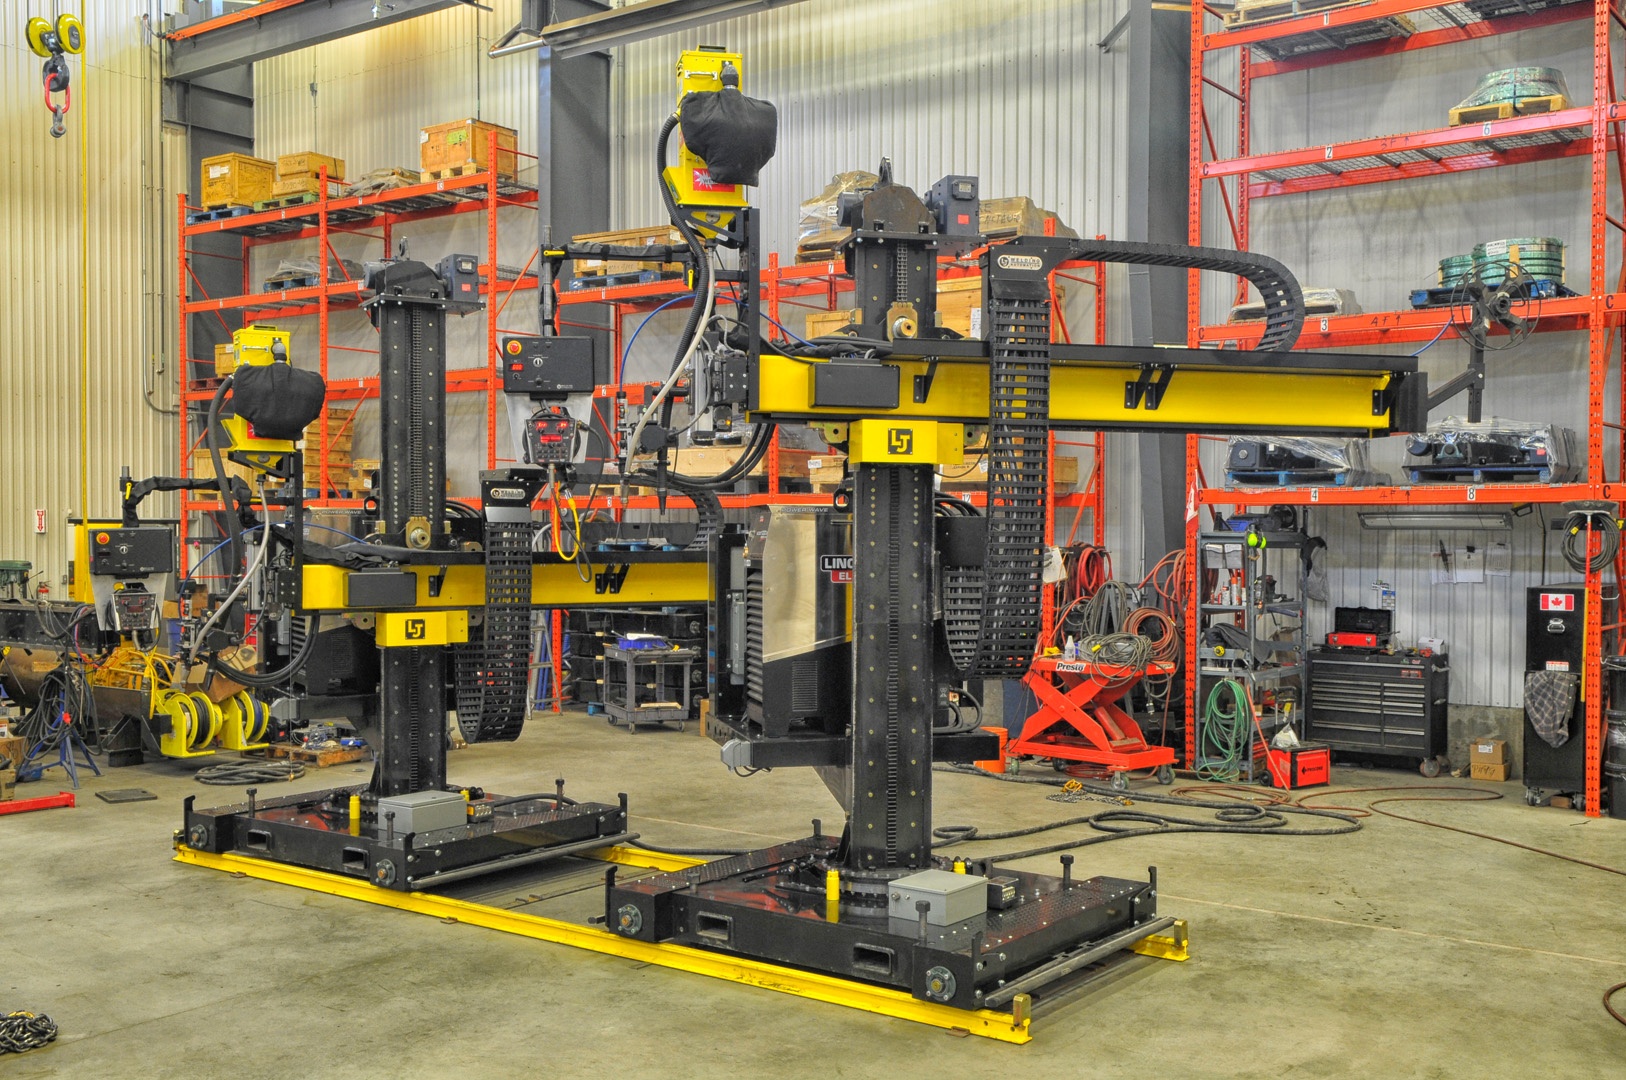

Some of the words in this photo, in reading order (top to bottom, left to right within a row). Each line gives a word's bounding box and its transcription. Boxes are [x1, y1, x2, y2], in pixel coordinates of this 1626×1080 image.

[1204, 35, 1210, 48] C
[1609, 104, 1618, 118] C
[1483, 122, 1490, 135] 6
[1326, 146, 1332, 159] 2
[1202, 163, 1209, 176] C
[1605, 294, 1613, 309] C
[1321, 318, 1328, 331] 3
[1198, 327, 1205, 340] C
[890, 429, 911, 453] LJ
[1311, 489, 1318, 500] 4
[1468, 487, 1475, 500] 8
[1603, 485, 1611, 499] C
[407, 620, 423, 638] LJ
[1056, 662, 1085, 672] Presto
